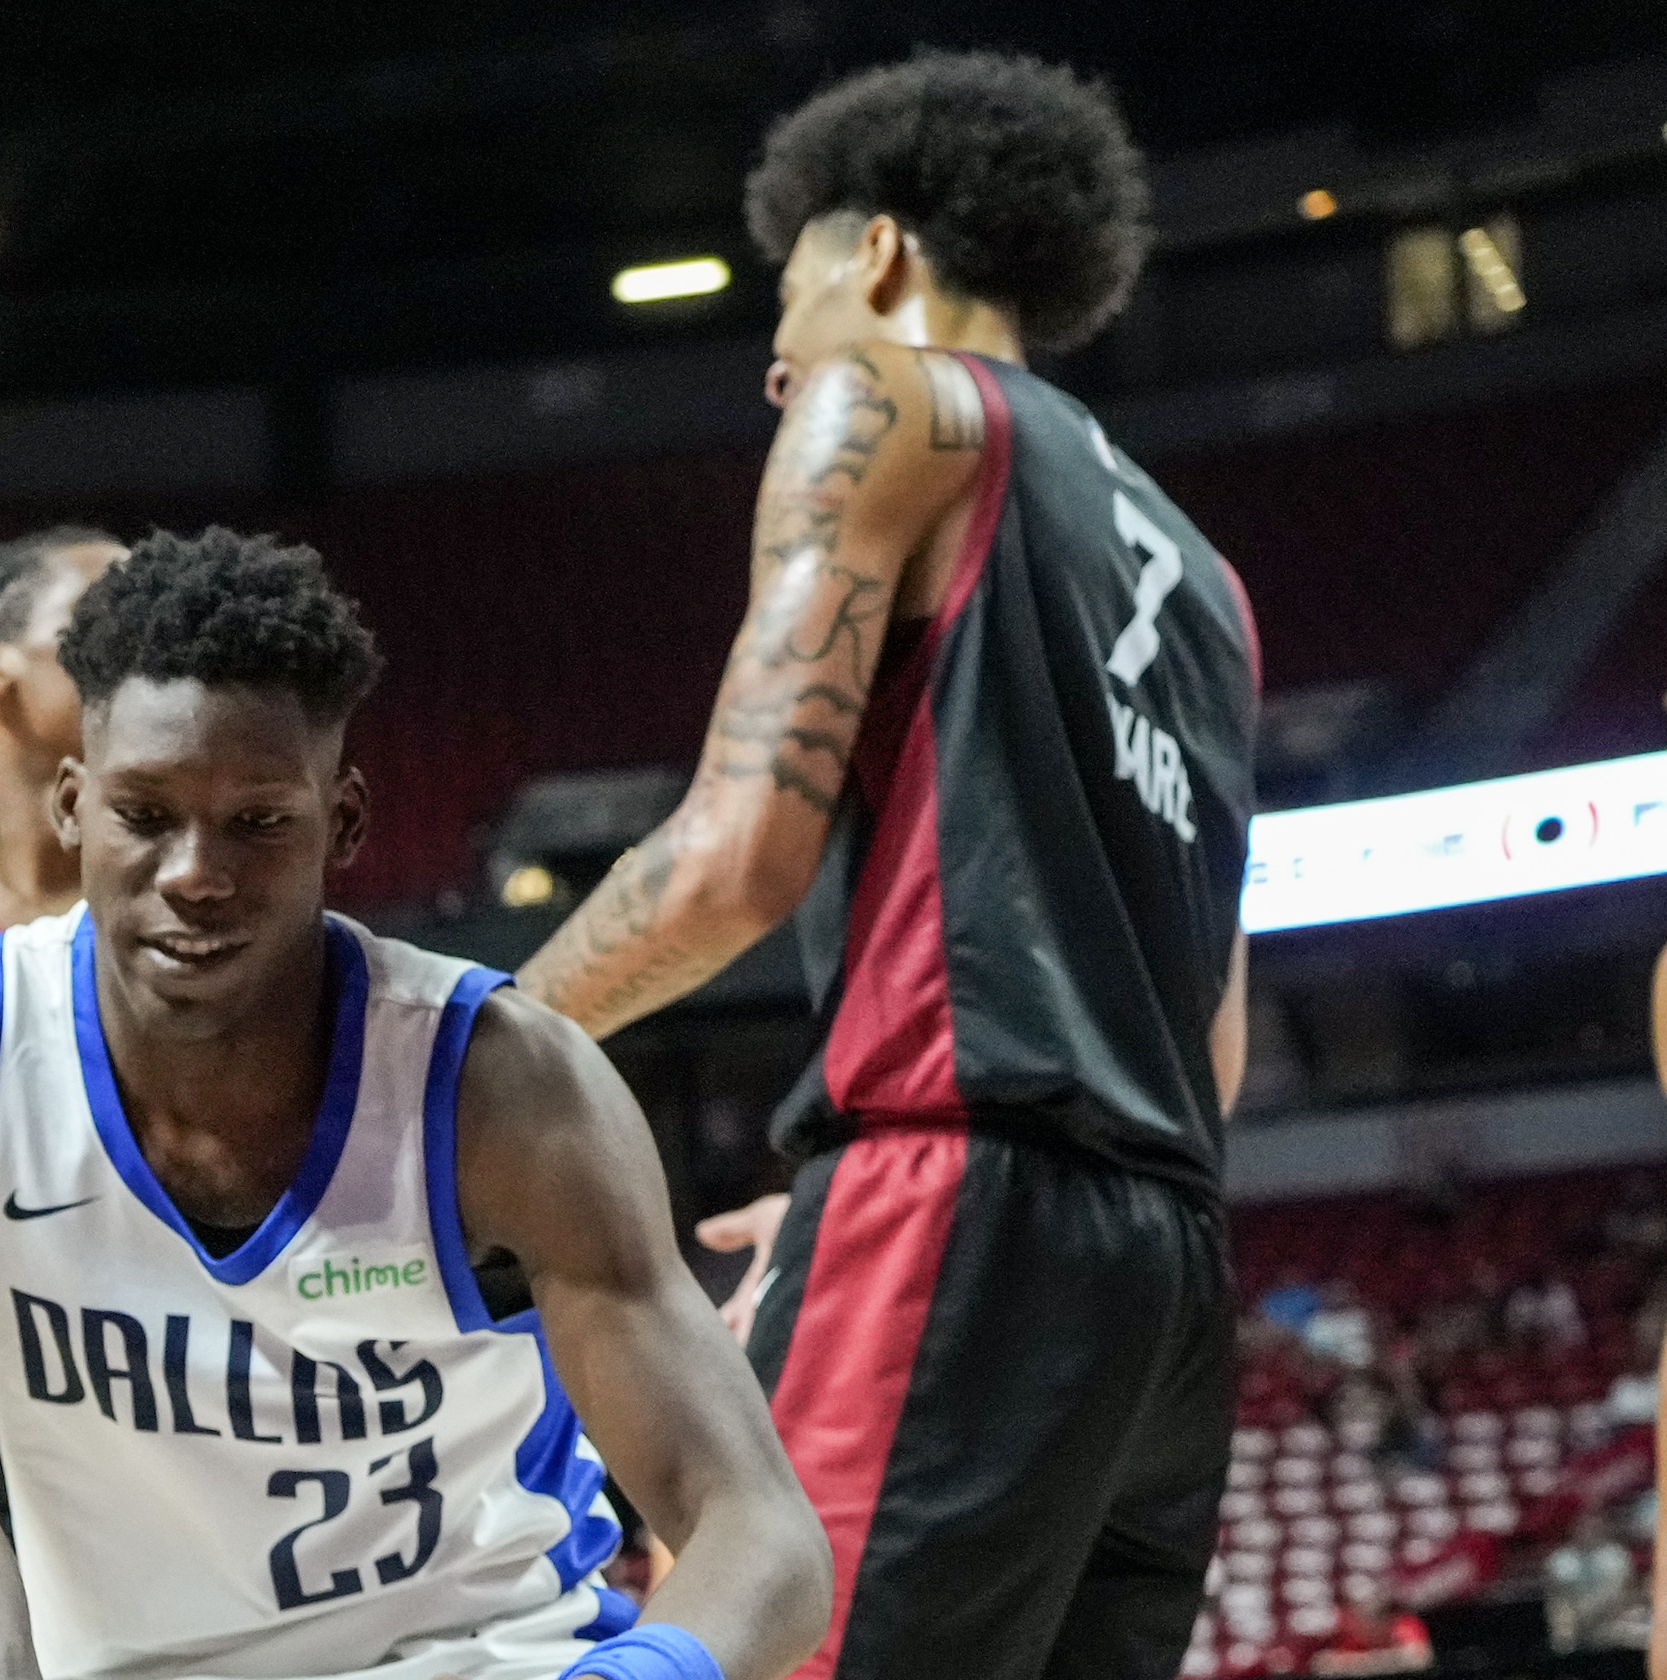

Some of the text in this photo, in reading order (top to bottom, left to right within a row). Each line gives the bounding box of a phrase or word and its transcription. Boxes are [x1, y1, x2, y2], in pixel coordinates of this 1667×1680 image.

[1105, 488, 1184, 687] 7
[298, 1256, 428, 1300] chime
[9, 1287, 444, 1445] DALLAS
[267, 1436, 442, 1612] 23
